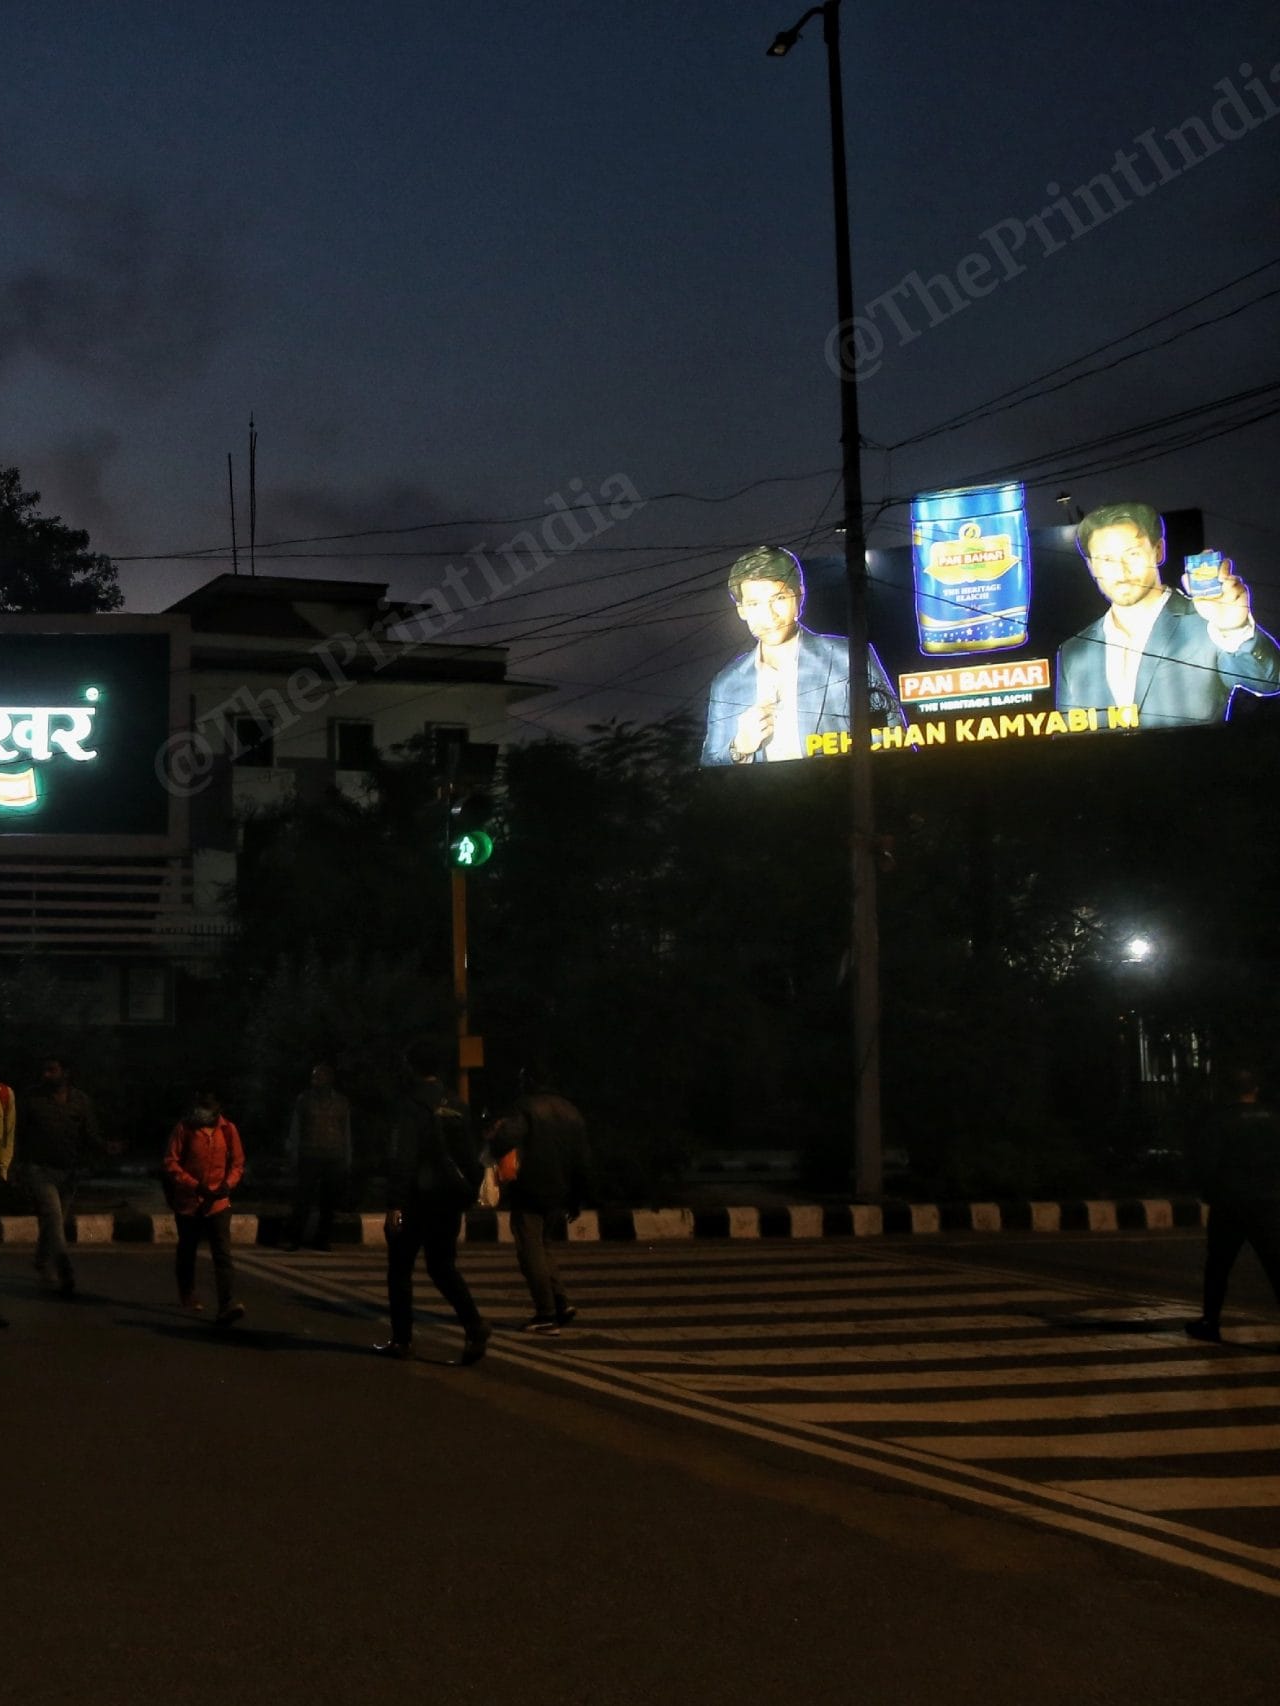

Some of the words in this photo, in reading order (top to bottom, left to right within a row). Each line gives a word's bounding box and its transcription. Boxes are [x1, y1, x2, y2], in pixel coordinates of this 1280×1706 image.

[904, 674, 953, 697] PAN
[959, 665, 1043, 692] BAHAR
[956, 707, 1097, 742] KAMYABI
[1108, 704, 1139, 729] KI
